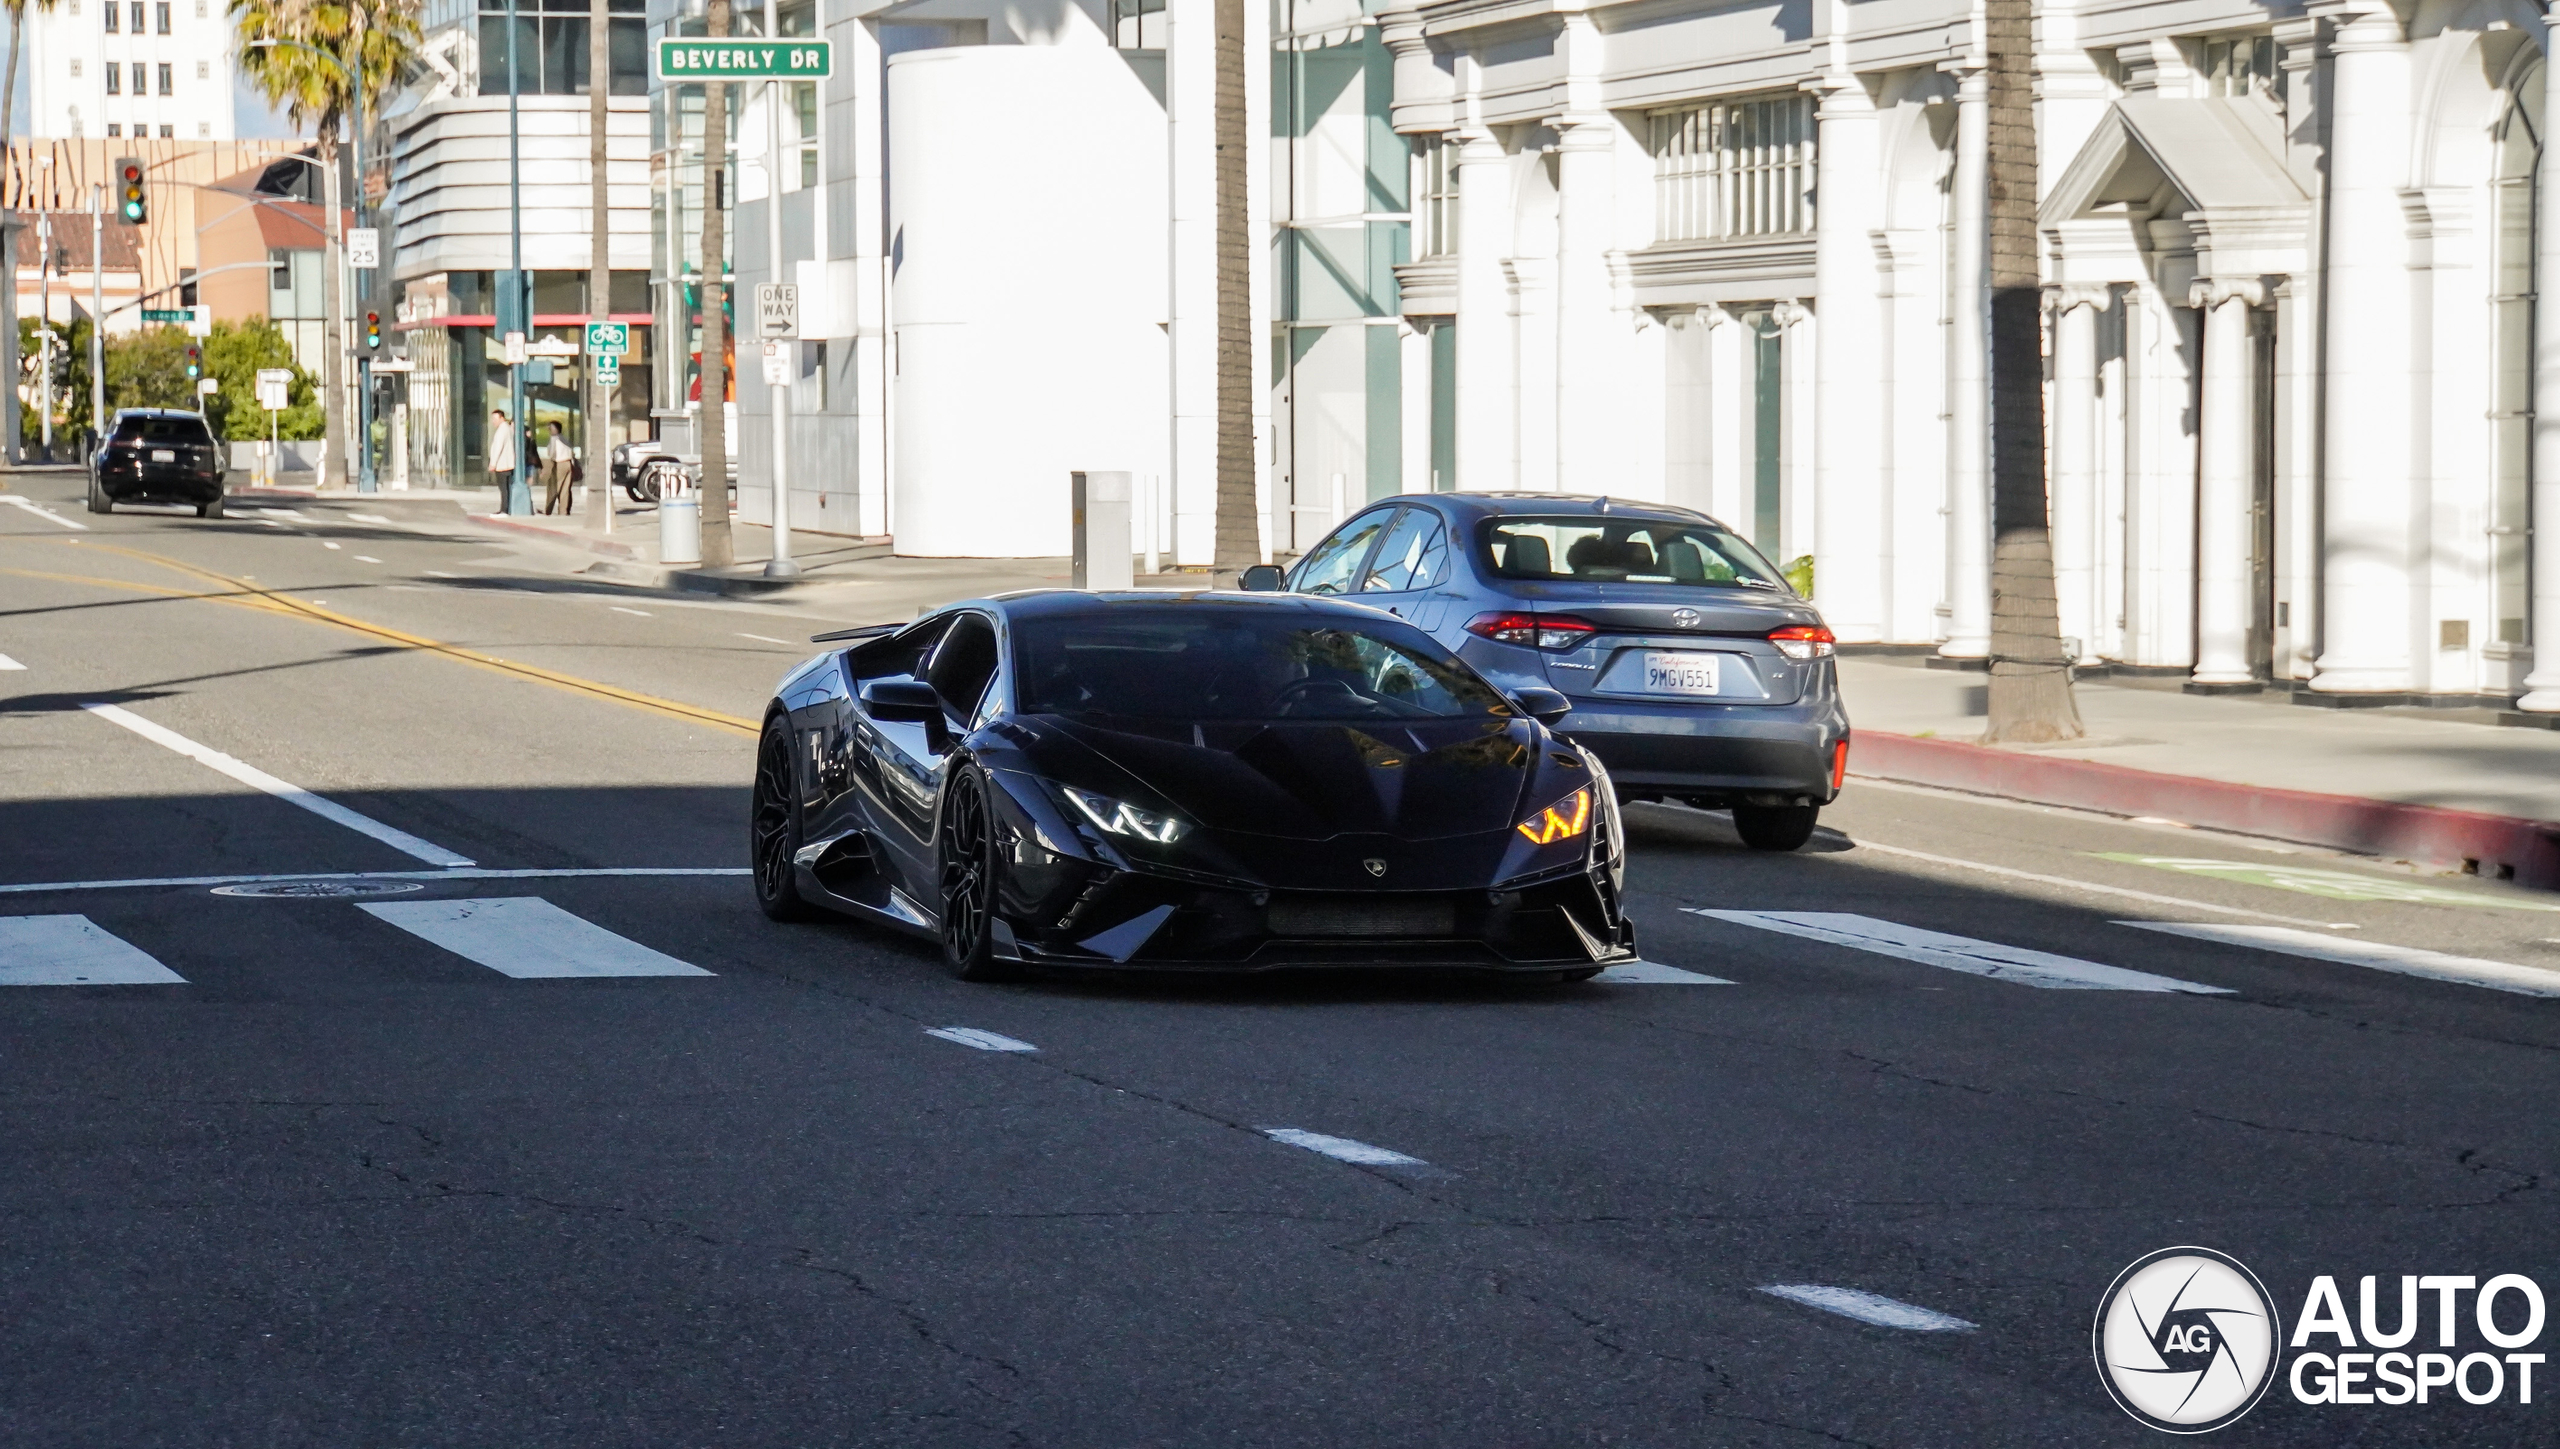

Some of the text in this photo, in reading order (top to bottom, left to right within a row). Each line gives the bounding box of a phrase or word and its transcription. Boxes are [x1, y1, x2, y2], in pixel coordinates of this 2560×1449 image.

[672, 50, 820, 69] BEVERLY DR
[353, 250, 375, 263] 25
[763, 288, 793, 301] ONE
[763, 304, 794, 316] WAY
[1659, 656, 1700, 667] California
[1649, 668, 1713, 688] 9MGV551
